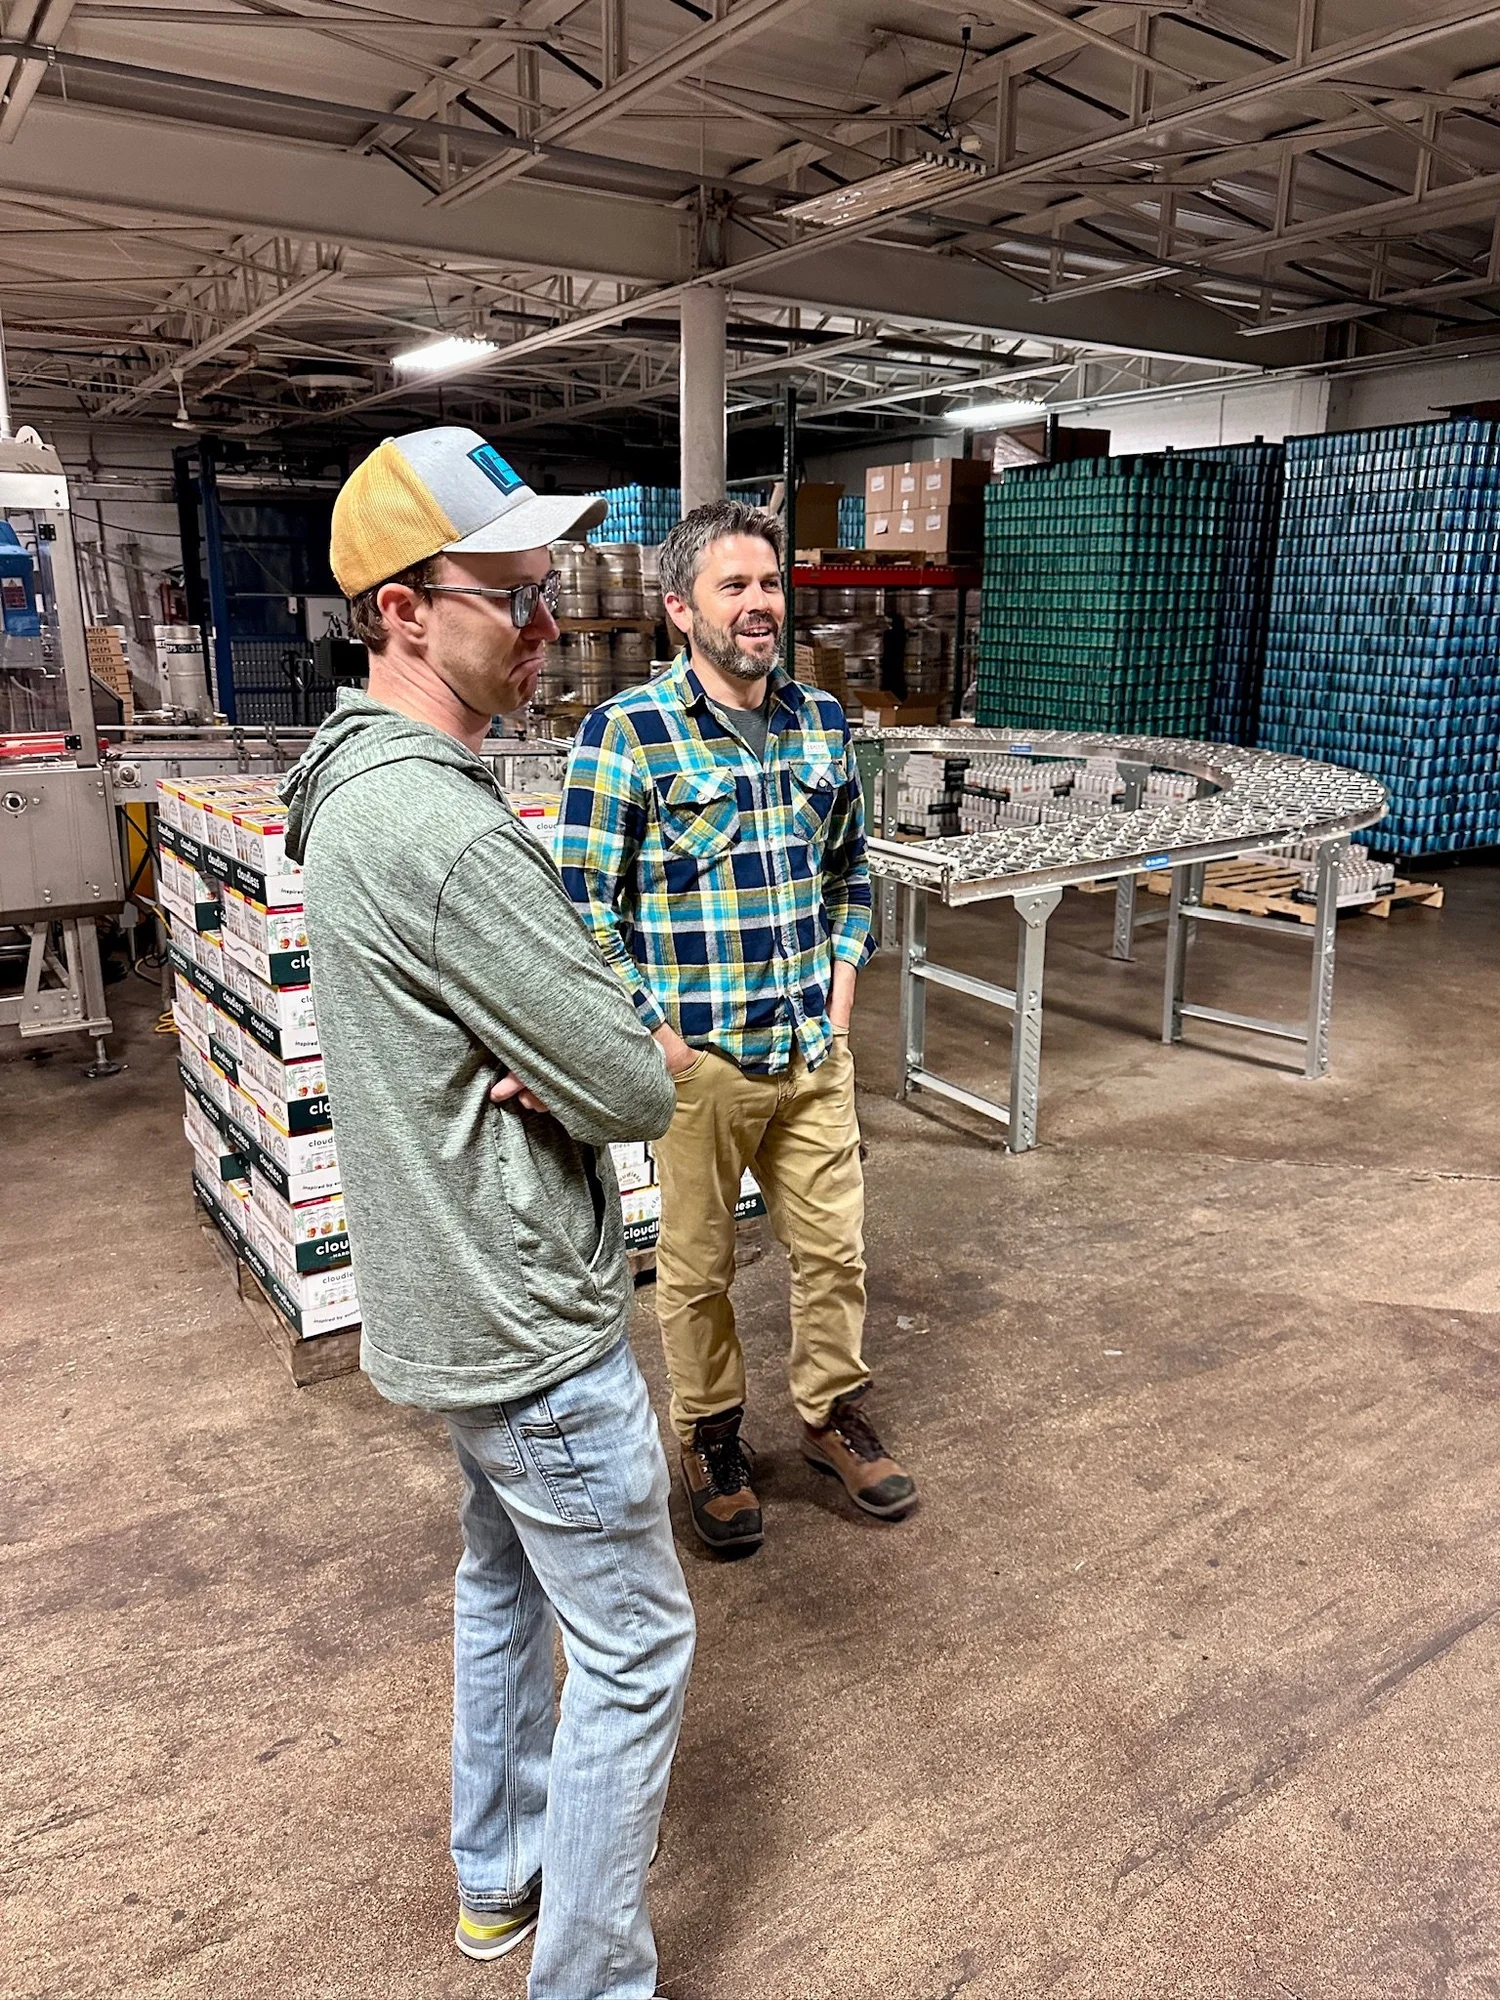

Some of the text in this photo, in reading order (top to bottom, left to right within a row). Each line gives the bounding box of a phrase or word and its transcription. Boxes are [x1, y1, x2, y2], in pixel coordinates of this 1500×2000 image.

[236, 867, 260, 889] cloudless
[250, 1014, 274, 1041] cloudless
[735, 1199, 757, 1211] less
[315, 1240, 348, 1255] clou
